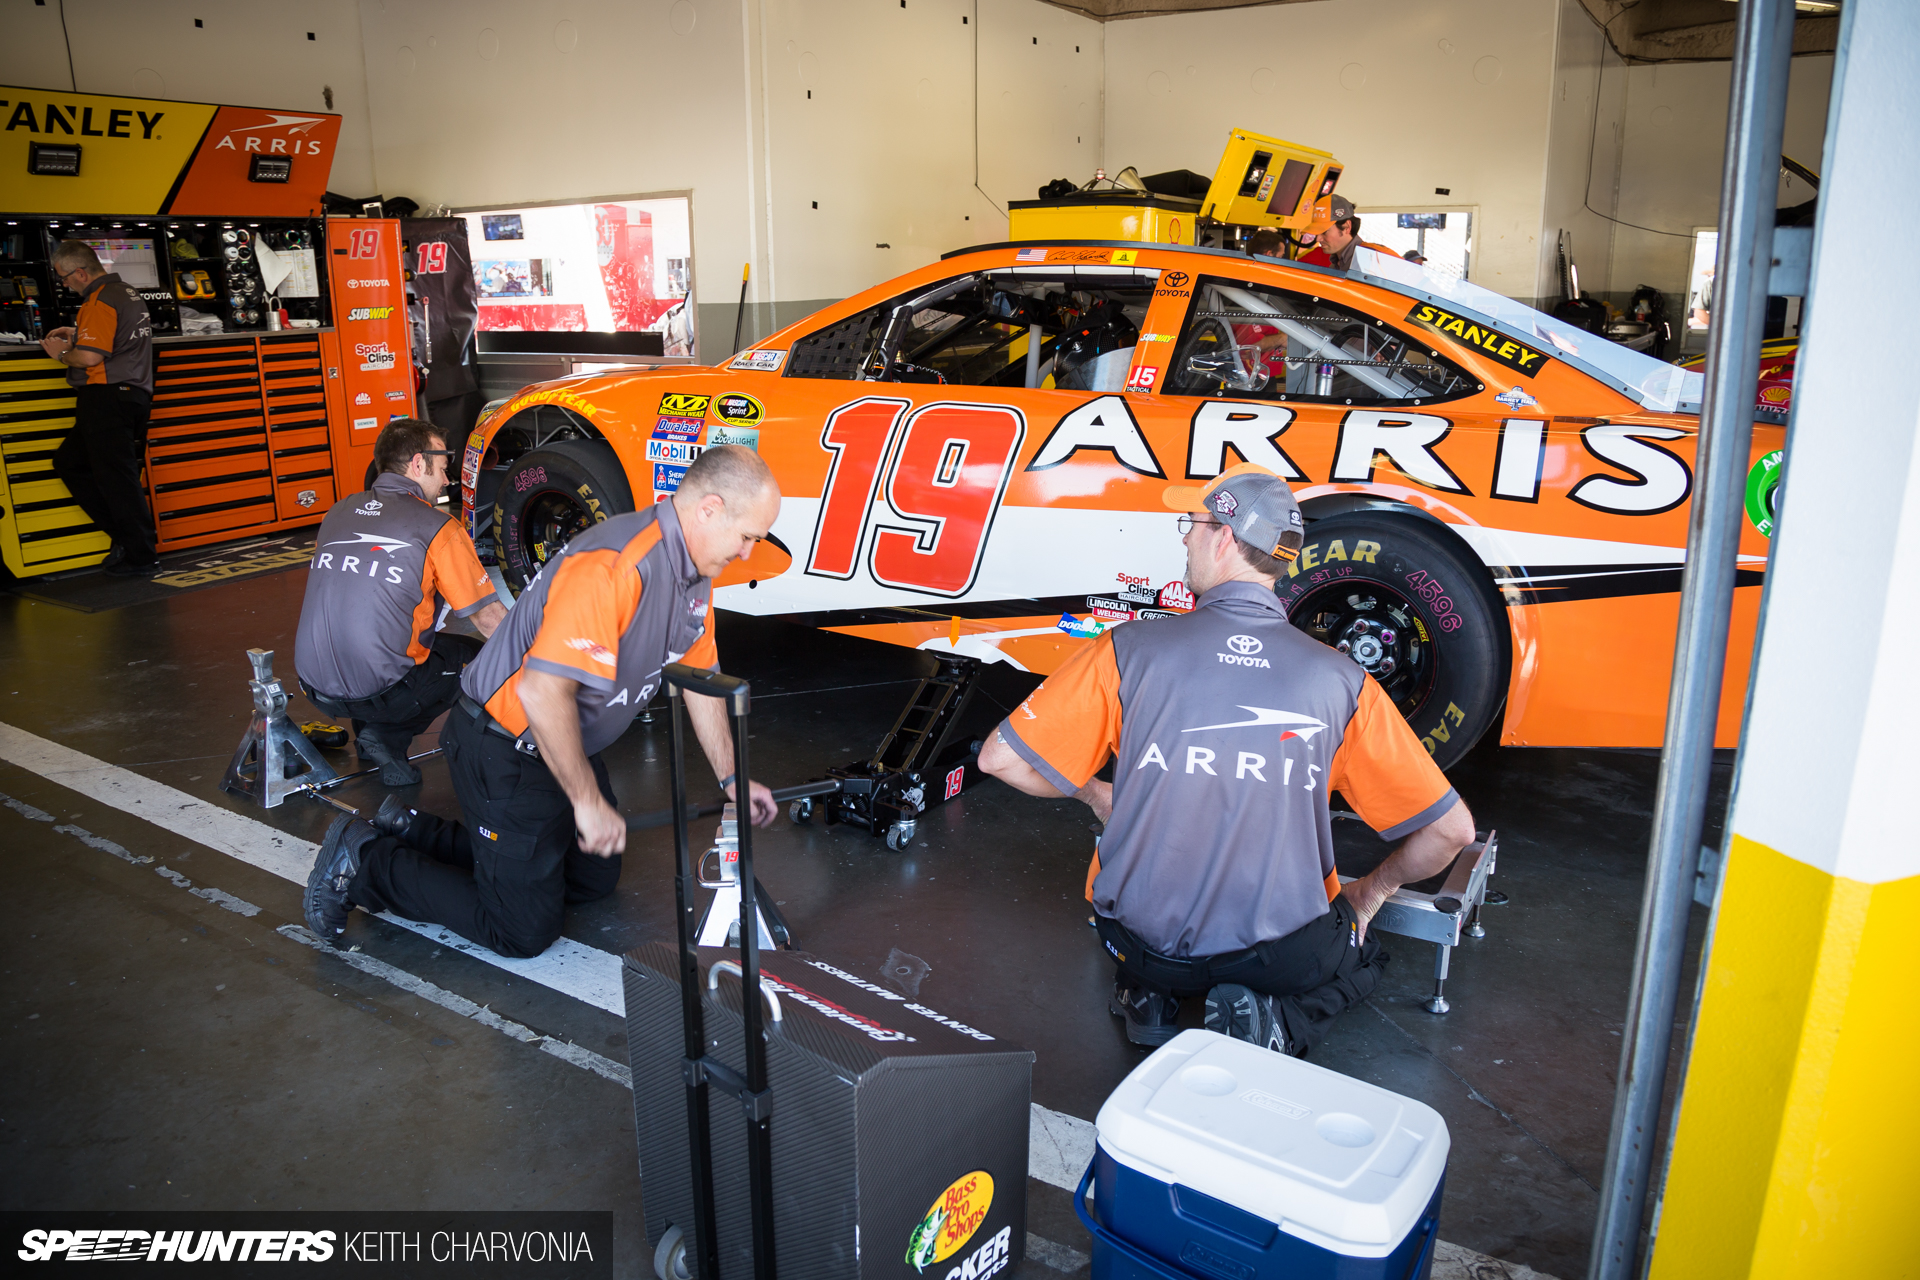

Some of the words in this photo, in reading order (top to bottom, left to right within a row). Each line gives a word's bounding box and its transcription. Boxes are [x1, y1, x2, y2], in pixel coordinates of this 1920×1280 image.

[0, 102, 164, 140] ANLEY
[215, 134, 321, 155] ARRIS
[349, 228, 379, 259] 19
[416, 241, 448, 274] 19
[359, 279, 390, 288] TOYOTA
[1154, 288, 1190, 299] TOYOTA
[347, 305, 394, 321] SUBWAY
[1140, 332, 1176, 343] SUBWAY
[1416, 305, 1540, 368] STANLEY
[355, 342, 388, 355] Sport
[368, 352, 395, 364] Clips
[1129, 367, 1157, 386] J5
[510, 388, 598, 419] GOODYEAR
[1495, 395, 1520, 404] BARNEY
[658, 406, 688, 416] MECHANIX
[687, 409, 705, 417] WEAR
[727, 406, 748, 415] Sprint
[658, 419, 701, 434] Duralast
[735, 437, 756, 446] LIGHT
[649, 441, 687, 459] Mobil
[1024, 395, 1694, 517] ARRIS
[515, 467, 548, 492] 4596
[803, 395, 1027, 600] 19
[355, 508, 381, 517] TOYOTA
[510, 514, 519, 524] UP
[509, 526, 518, 541] SET
[1116, 572, 1150, 586] Sport
[1310, 569, 1331, 583] SET
[1336, 566, 1353, 576] UP
[1119, 592, 1154, 603] HAIRCUTS
[1128, 584, 1156, 597] Clips
[1161, 582, 1194, 602] MAC
[1089, 598, 1128, 612] LINCOLN
[1161, 599, 1194, 610] TOOLS
[1405, 569, 1463, 633] 4596
[1096, 608, 1131, 620] WELDERS
[1217, 653, 1271, 669] TOYOTA
[1137, 742, 1323, 792] ARRIS
[945, 766, 965, 801] 19
[479, 826, 491, 839] 5.11
[724, 851, 739, 862] 19
[1106, 940, 1119, 957] 5.11
[807, 960, 906, 1001] MATTRESS
[903, 1003, 996, 1041] DENVER
[944, 1176, 977, 1212] Bass
[944, 1200, 970, 1230] Pro
[944, 1205, 985, 1249] Shops
[945, 1225, 1012, 1280] CKER
